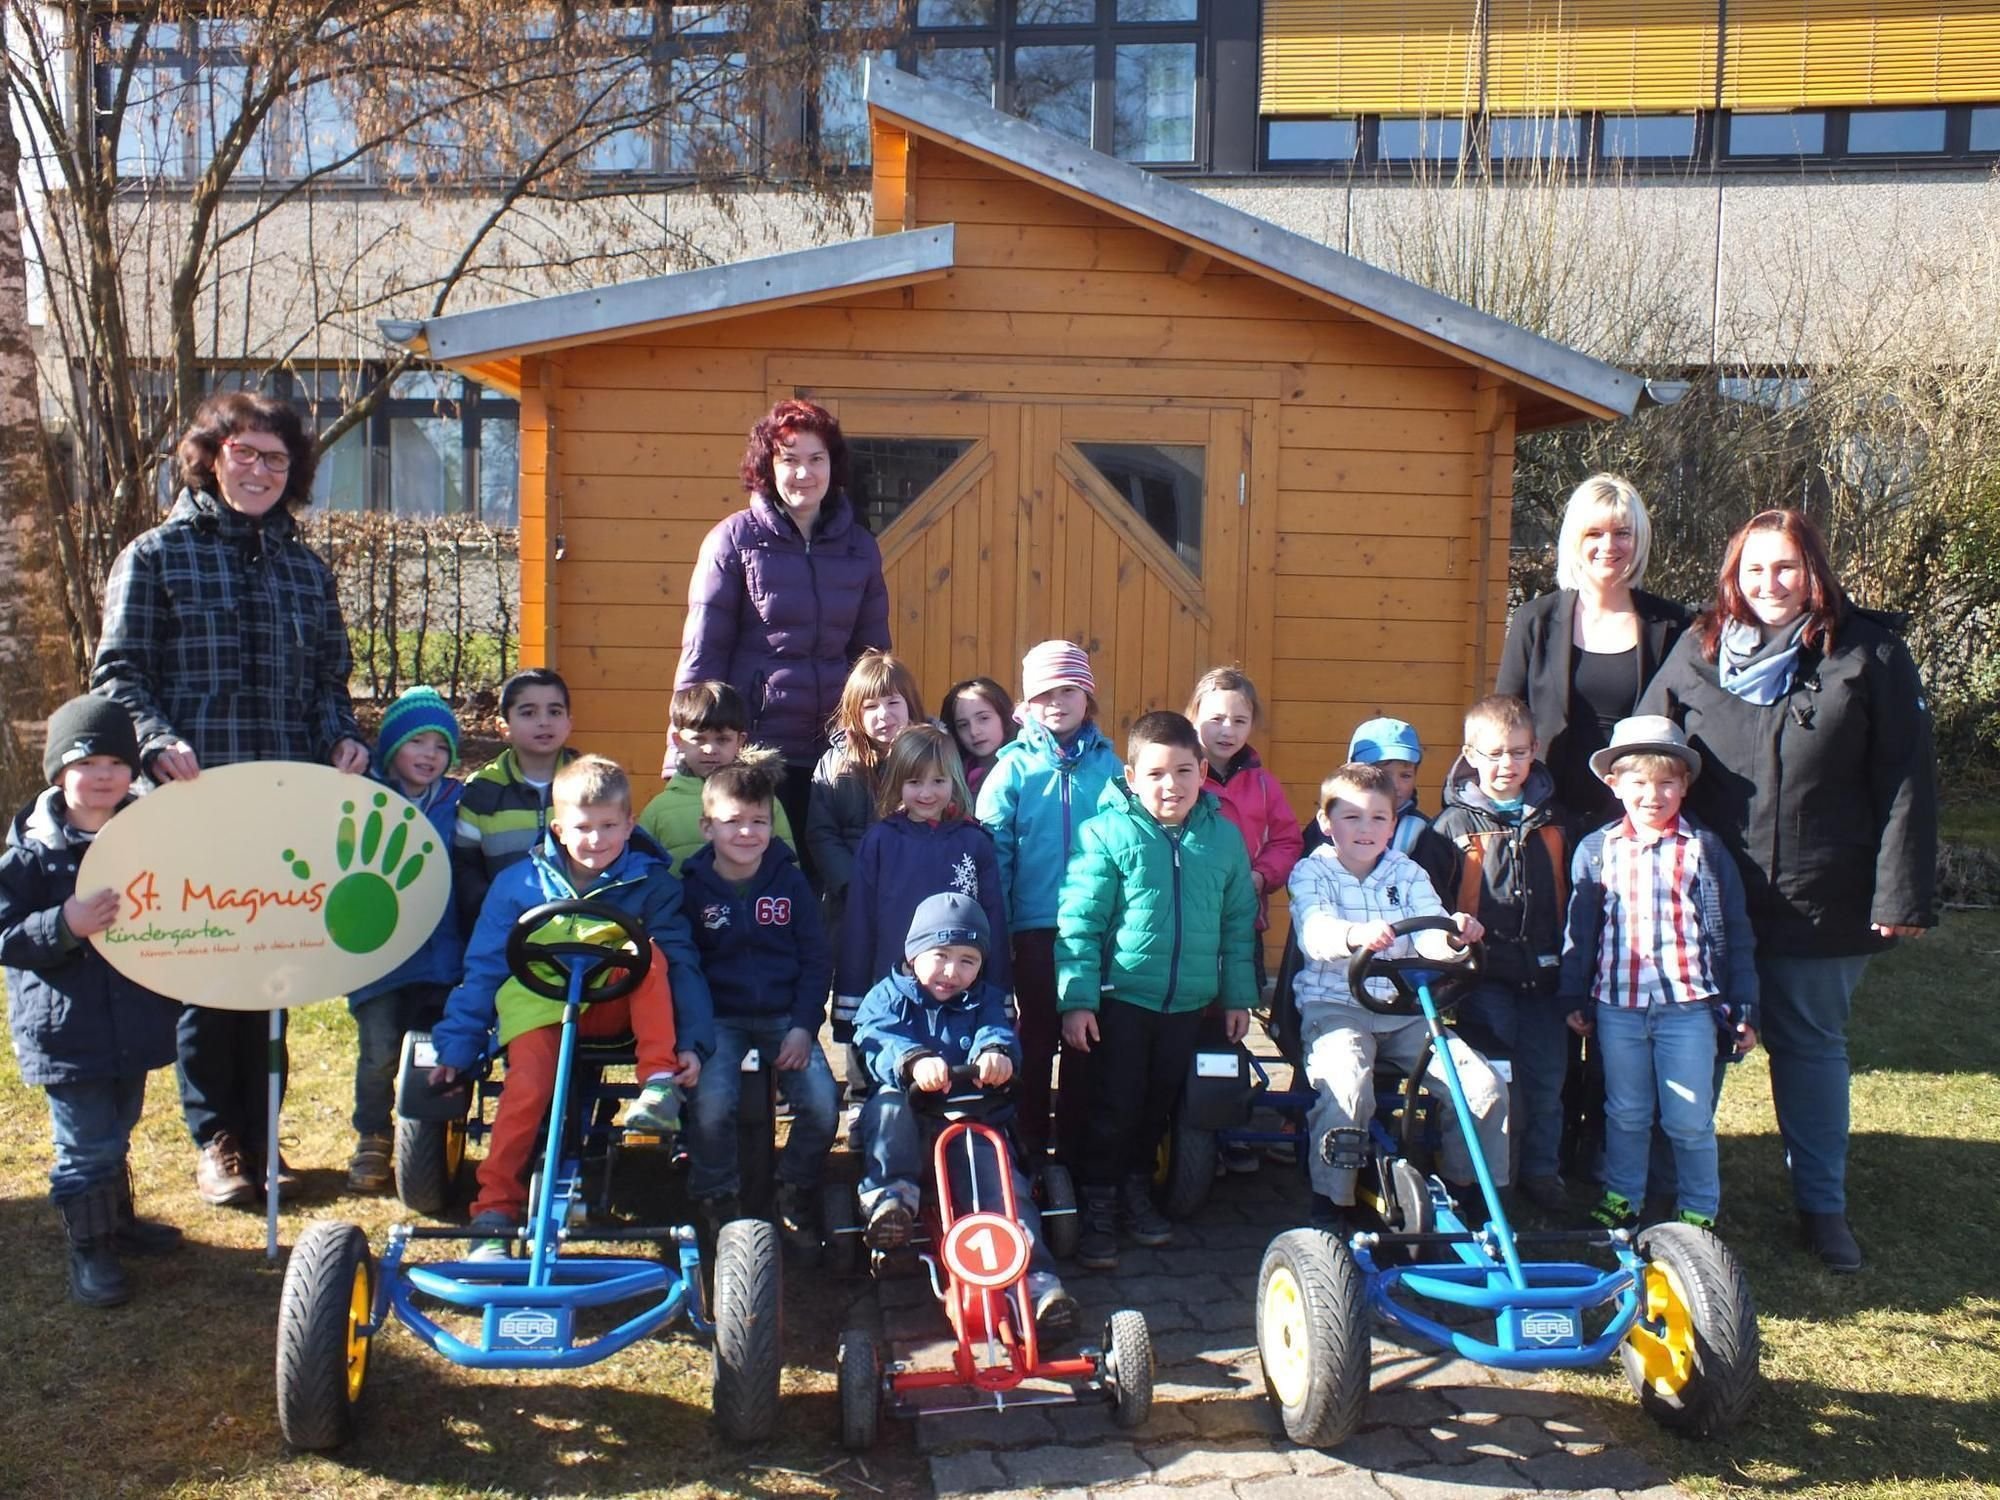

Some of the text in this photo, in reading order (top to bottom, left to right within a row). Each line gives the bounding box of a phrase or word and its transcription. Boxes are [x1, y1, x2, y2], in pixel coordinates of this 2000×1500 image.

[125, 871, 327, 924] St. Magnus
[755, 896, 792, 926] 63
[964, 1228, 999, 1271] 1
[502, 1321, 553, 1334] BERG
[1525, 1321, 1570, 1334] BERG
